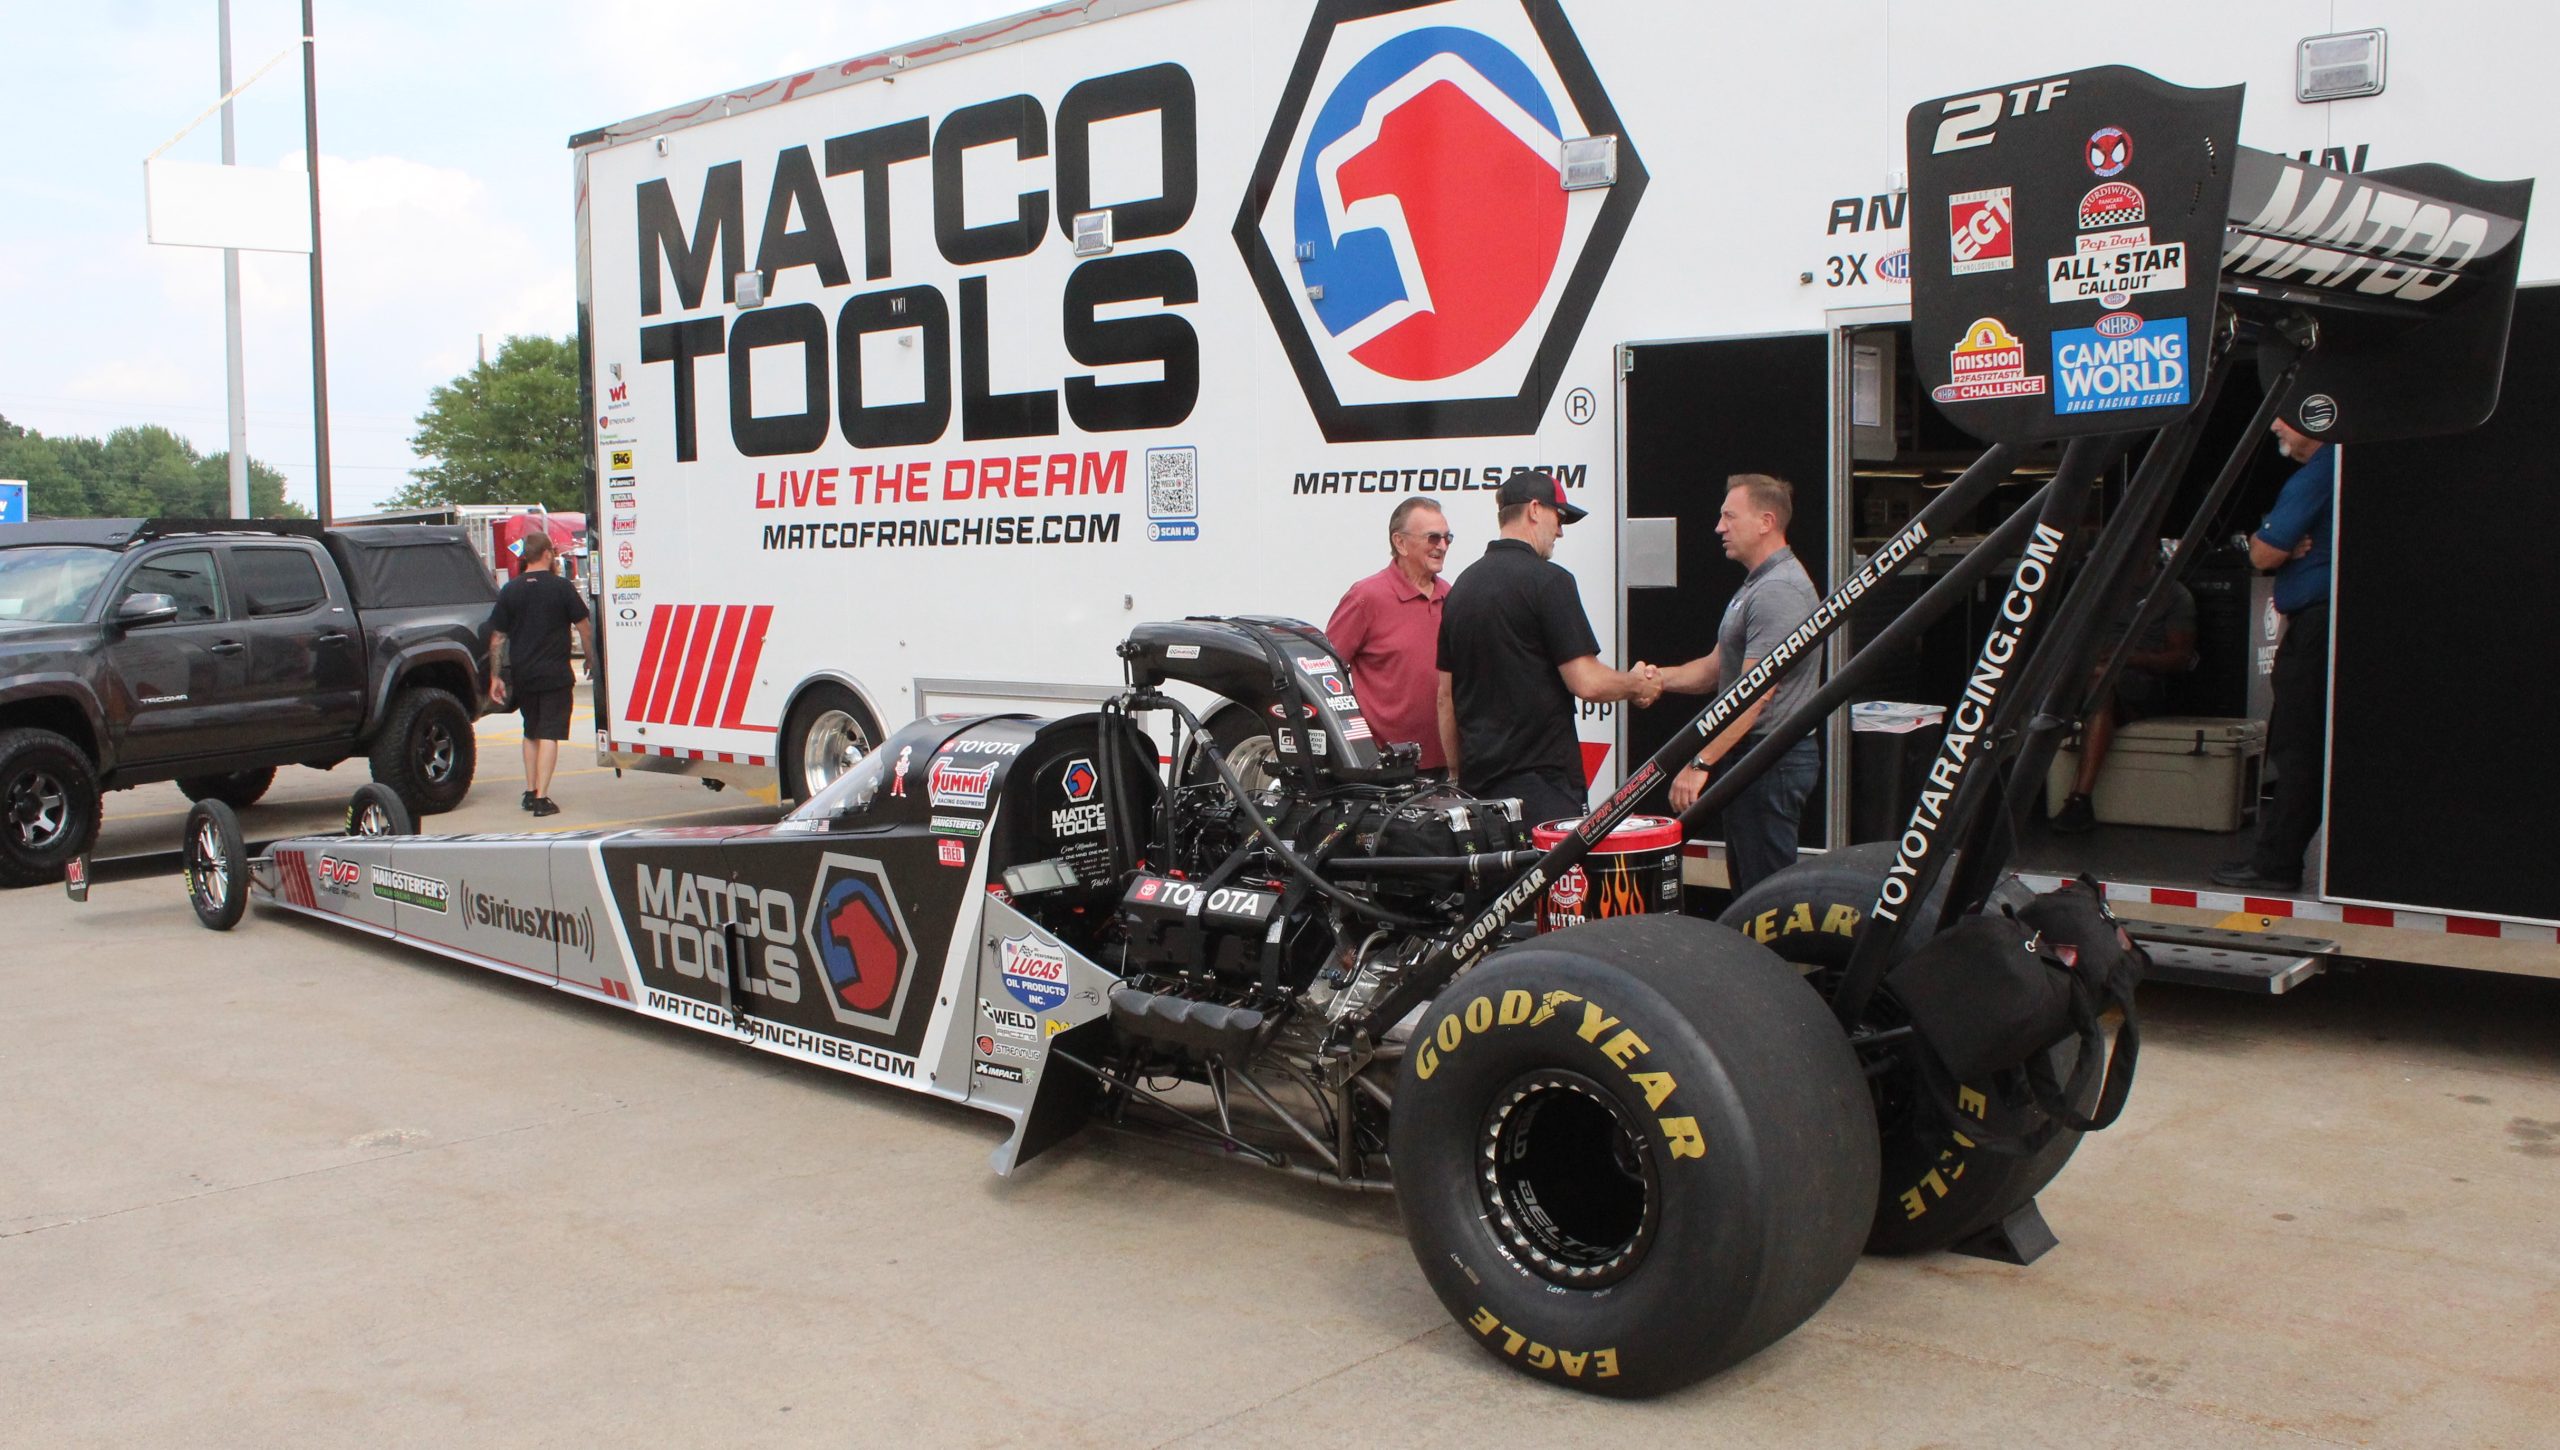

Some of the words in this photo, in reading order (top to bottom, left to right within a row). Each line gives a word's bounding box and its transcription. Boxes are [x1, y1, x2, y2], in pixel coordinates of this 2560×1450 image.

[1932, 92, 2004, 155] 2
[2009, 79, 2070, 117] TF
[636, 62, 1198, 317] MATCO
[2082, 184, 2141, 214] STURDIWHEAT
[1952, 197, 2011, 262] EGT
[2079, 237, 2108, 251] Pep
[2109, 232, 2146, 250] Boys
[1826, 252, 1869, 288] 3X
[2053, 256, 2101, 283] ALL
[2114, 246, 2181, 275] STAR
[2101, 316, 2137, 334] NHRA
[640, 248, 1200, 463] TOOLS
[1954, 349, 2021, 372] MISSION
[2058, 333, 2181, 370] CAMPING
[1953, 369, 2023, 384] #2FAST2TASTY
[1960, 380, 2041, 398] CHALLENGE
[2060, 359, 2184, 398] WORLD
[2066, 400, 2094, 412] DRAG
[2097, 396, 2138, 410] RACING
[2141, 392, 2181, 406] SERIES
[755, 467, 839, 509] LIVE
[848, 461, 932, 506] THE
[942, 449, 1129, 501] DREAM
[1293, 464, 1588, 495] MATCOTOOLSM
[763, 513, 1121, 550] MATCOFRANCHISE.COM
[1160, 526, 1182, 537] SCAN
[1183, 526, 1196, 536] ME
[1696, 521, 1929, 738] MATCOFRANCHISE.COM
[140, 694, 188, 705] TACOMA
[1871, 522, 2065, 922] TOYOTARACING.COM
[955, 740, 1021, 756] TOYOTA
[931, 760, 989, 796] SUMMIT
[1580, 801, 1613, 837] STAR
[1613, 762, 1656, 806] RACER
[931, 815, 982, 831] HANGSTERFER'S
[1051, 816, 1107, 838] TOOLS
[318, 855, 361, 886] FVP
[942, 846, 962, 861] FRED
[373, 867, 447, 900] HANGSTERFER'S
[1160, 881, 1260, 916] TOOTA
[636, 862, 797, 946] MATCO
[1452, 868, 1547, 960] GOODYEAR
[1549, 912, 1586, 928] NITRO
[1743, 902, 1861, 944] EAR
[640, 915, 801, 1004] TOOLS
[1008, 956, 1063, 980] LUCAS
[1006, 978, 1021, 989] OIL
[1021, 981, 1067, 998] PRODUCTS
[1028, 994, 1046, 1006] INC.
[993, 1009, 1037, 1030] WELD
[1416, 990, 1706, 1160] GOODYEAR
[1469, 1306, 1620, 1378] EAGLE
